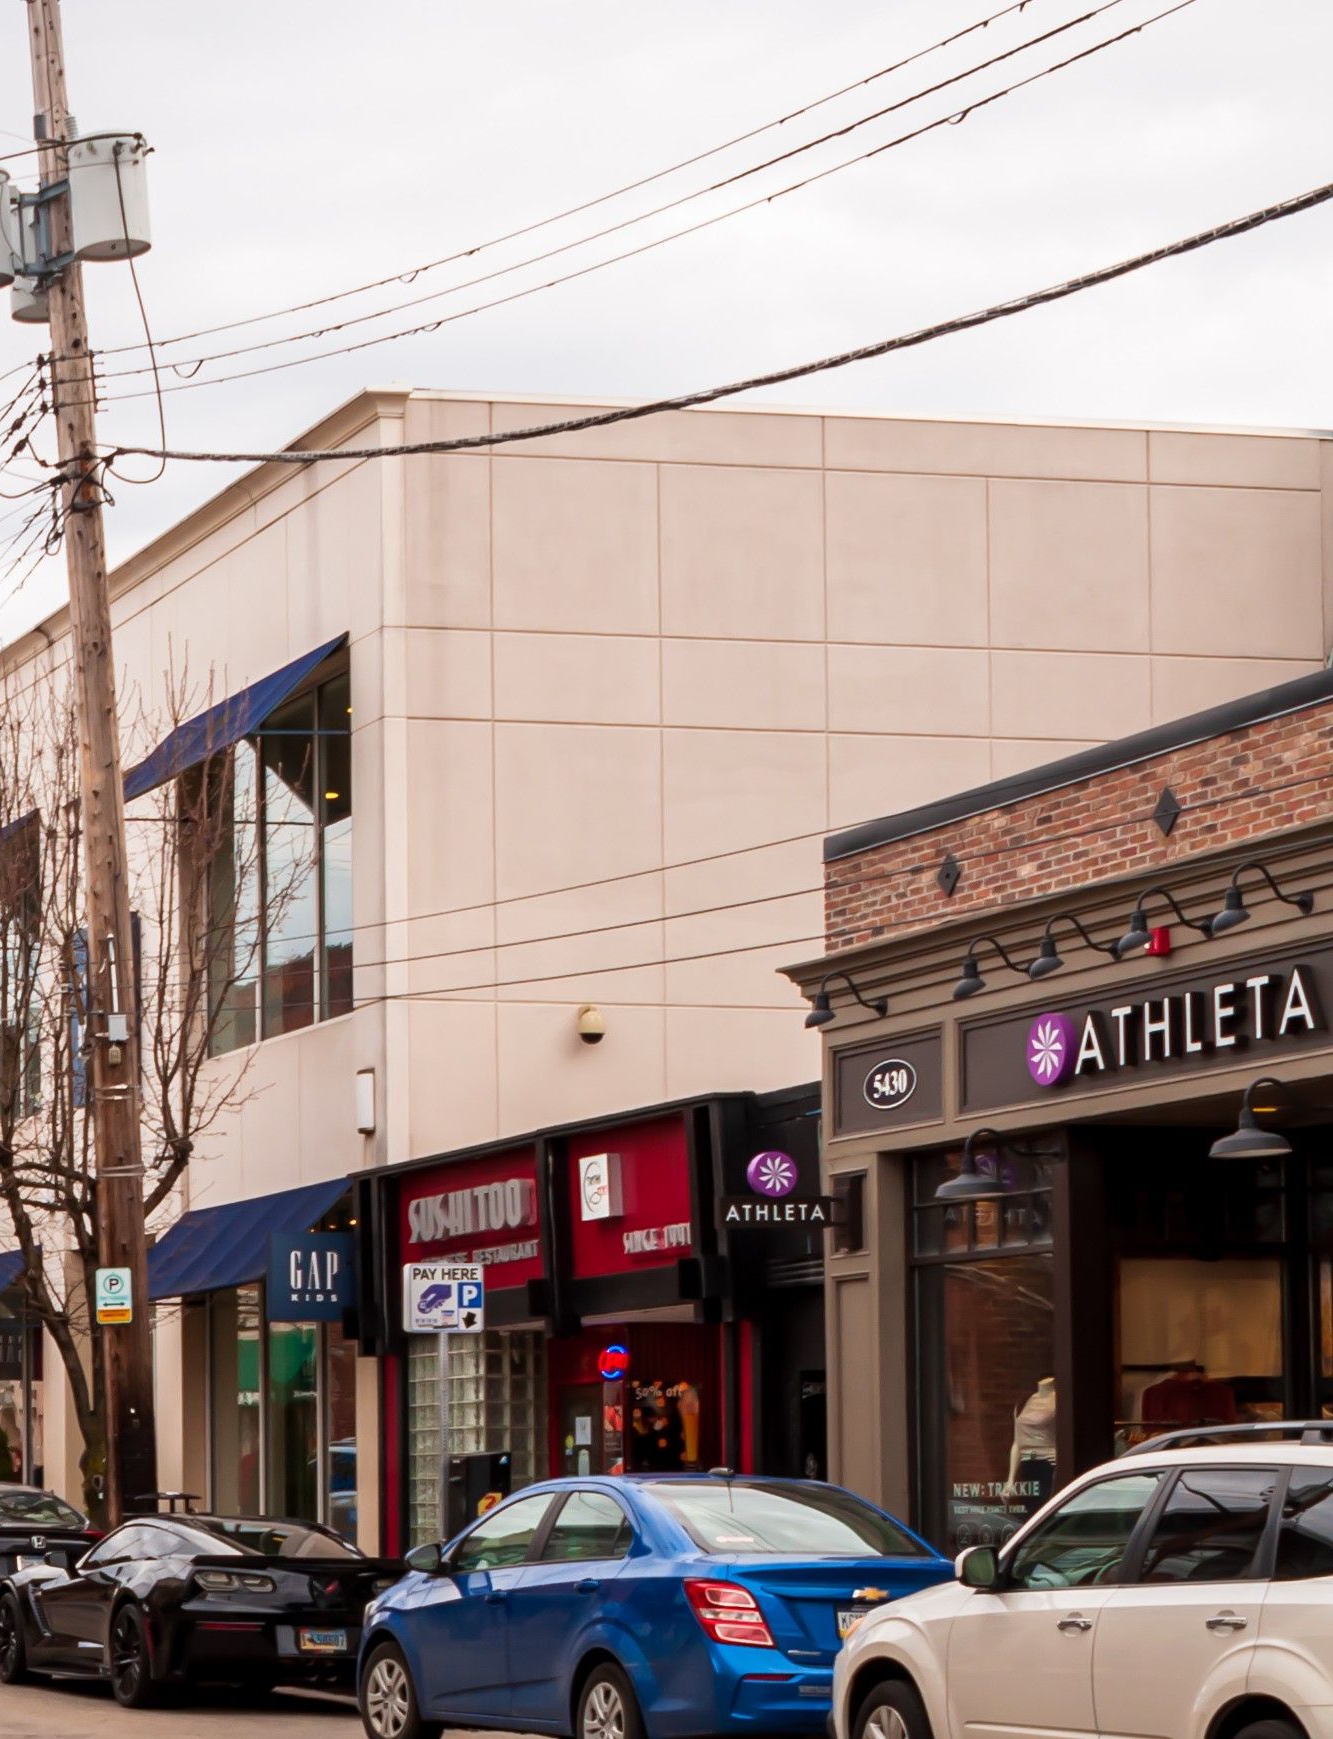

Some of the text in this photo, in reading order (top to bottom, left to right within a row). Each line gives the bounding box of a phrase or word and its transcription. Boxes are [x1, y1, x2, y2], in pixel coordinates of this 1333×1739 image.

[1075, 968, 1315, 1075] ATHLETA
[873, 1069, 908, 1098] 5430
[408, 1178, 524, 1244] SUSHI TOO
[726, 1204, 825, 1221] ATHLETA
[290, 1250, 339, 1290] GAP
[413, 1267, 479, 1281] PAY HERE
[291, 1294, 338, 1302] KIDS
[462, 1285, 478, 1307] P
[953, 1481, 1041, 1498] NEW: TRKKIE
